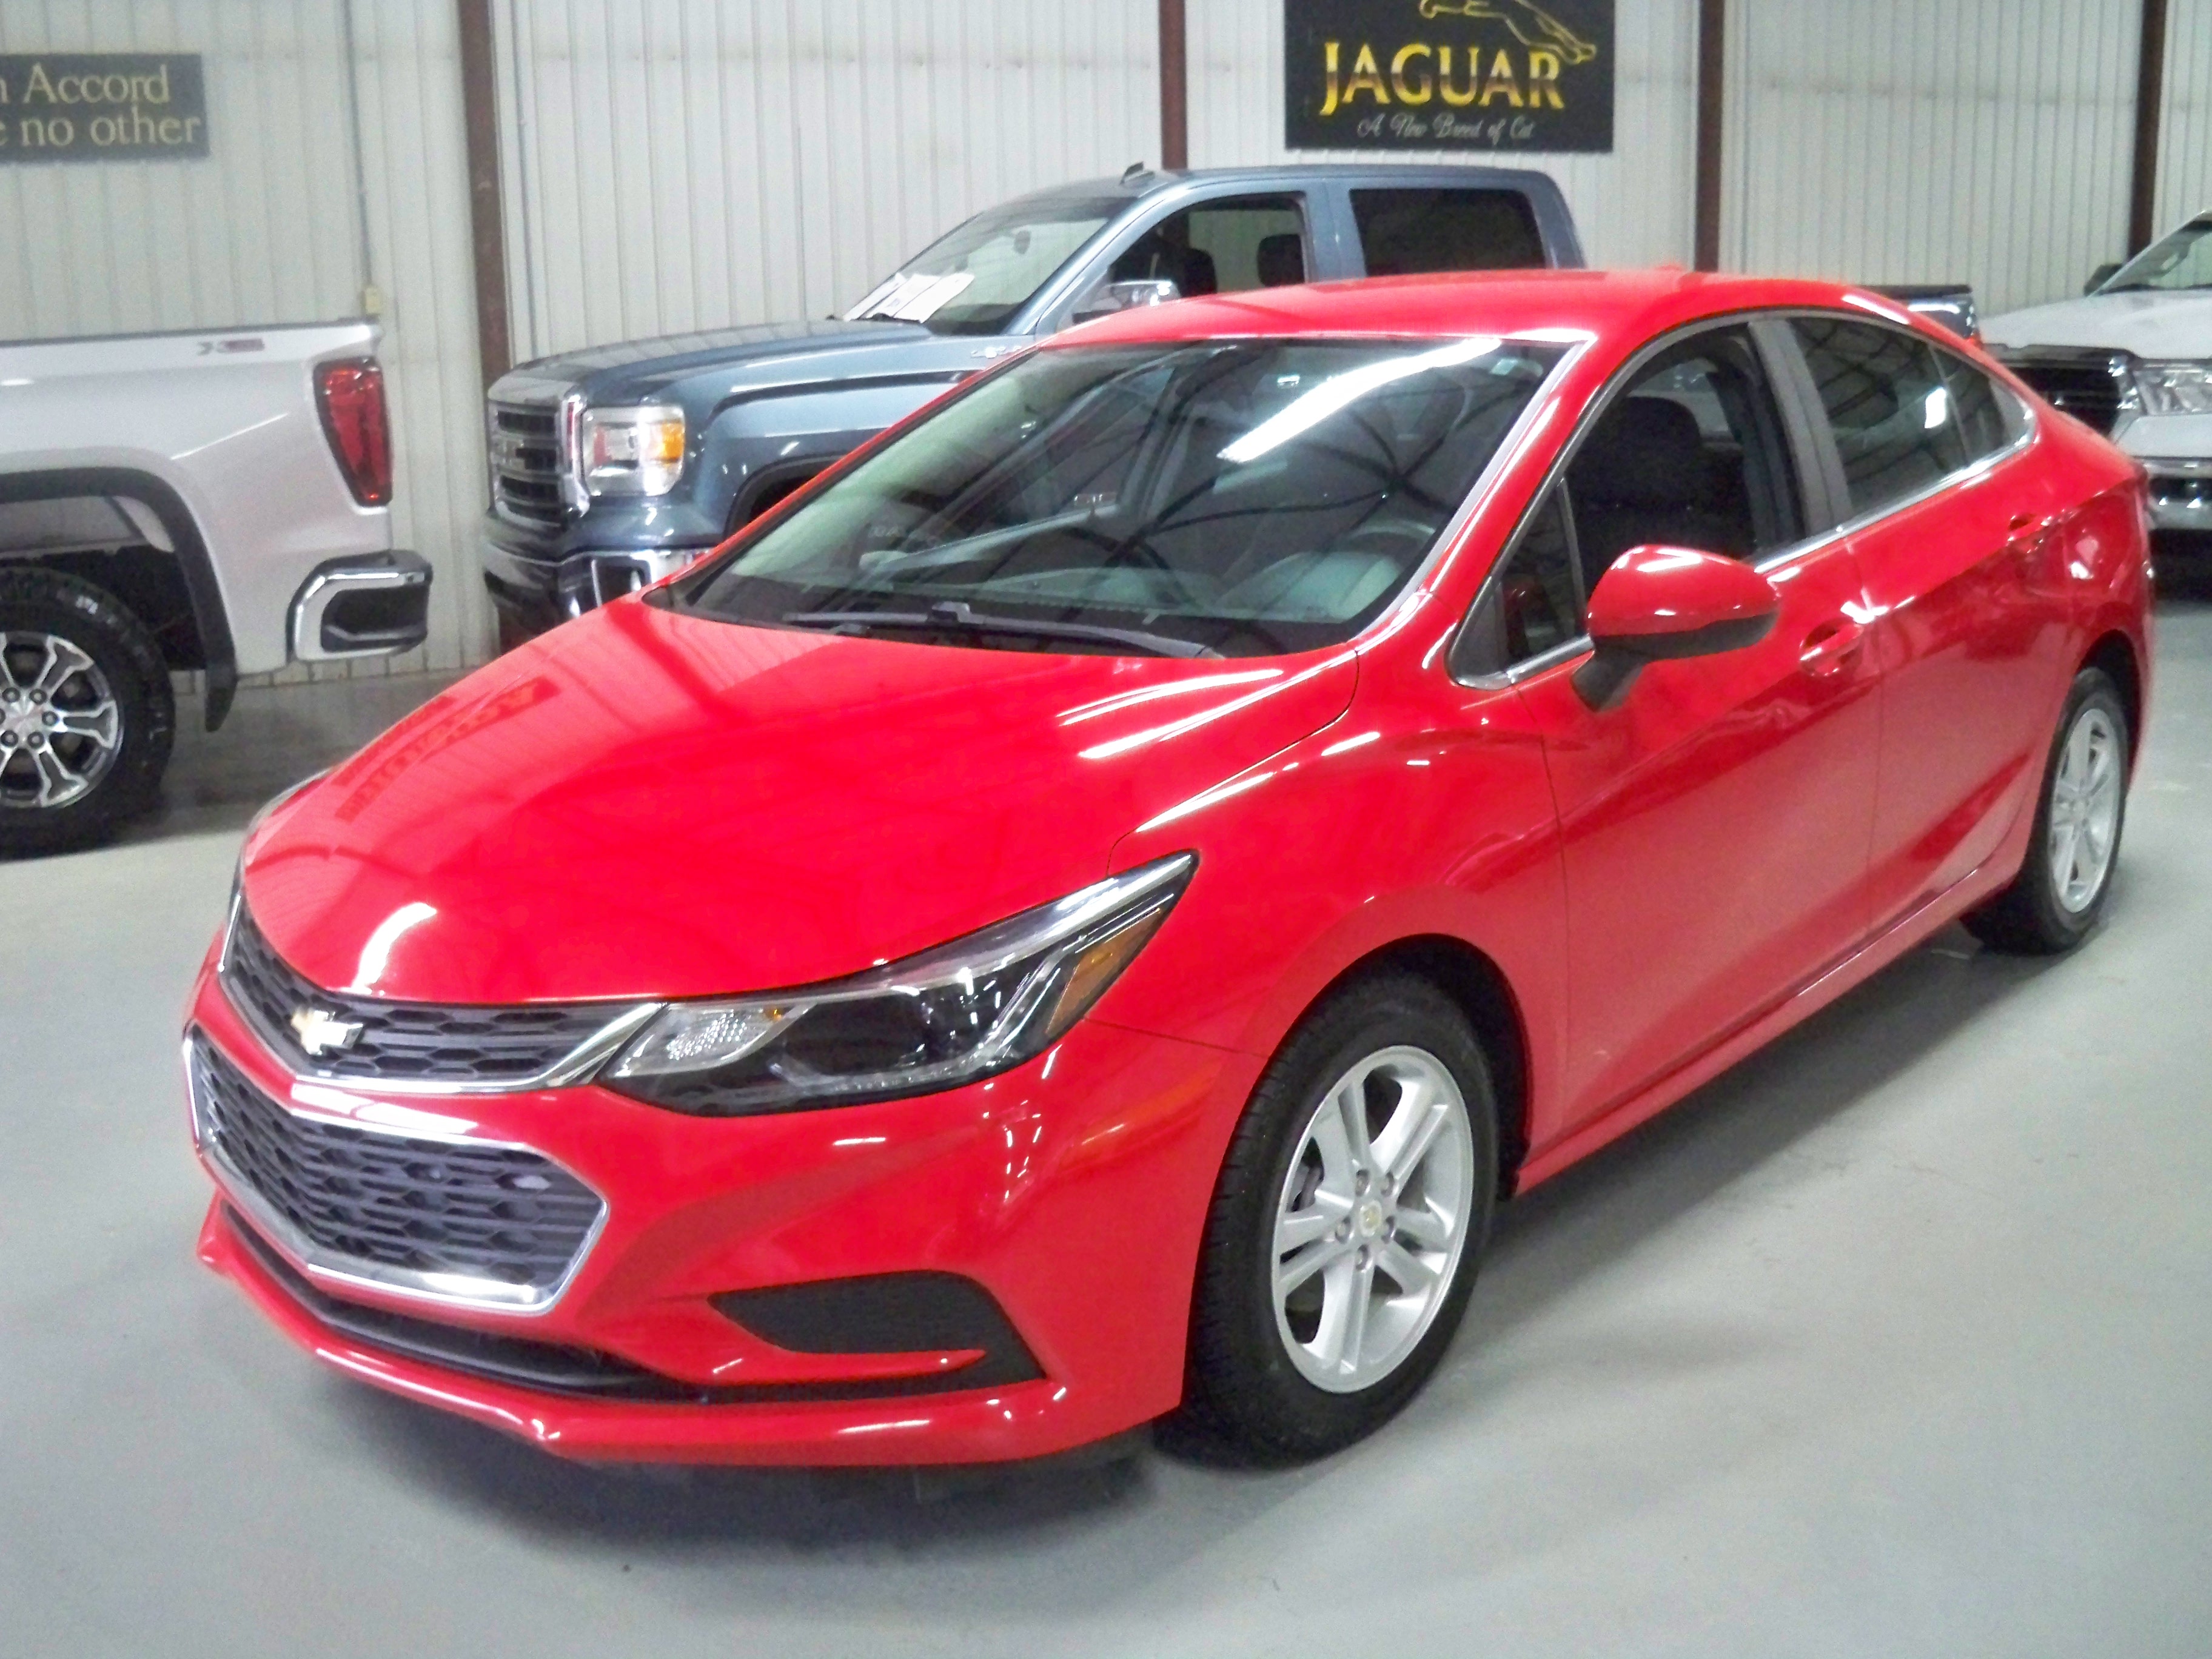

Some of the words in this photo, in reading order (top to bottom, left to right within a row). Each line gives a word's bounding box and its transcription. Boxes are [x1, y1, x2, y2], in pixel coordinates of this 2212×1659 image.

[22, 62, 170, 104] Accord
[1319, 41, 1564, 116] JAGUAR
[20, 117, 74, 147] no
[90, 104, 201, 147] other
[1487, 118, 1506, 146] of
